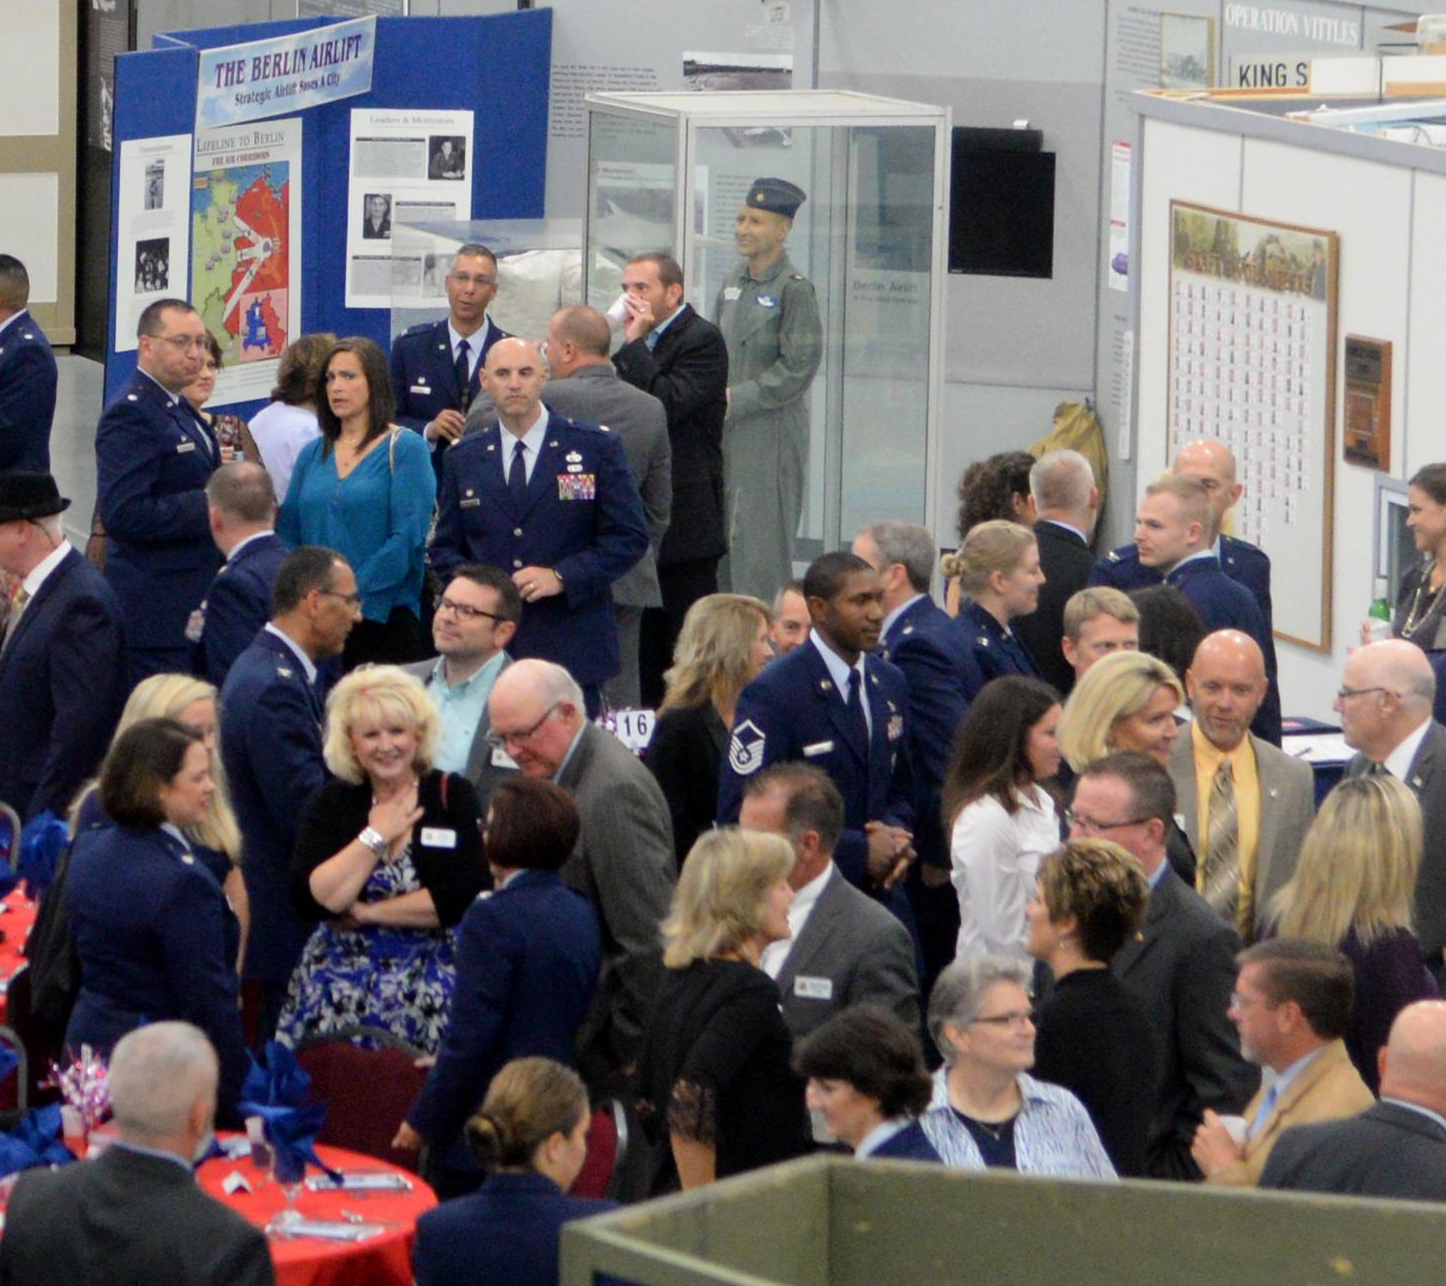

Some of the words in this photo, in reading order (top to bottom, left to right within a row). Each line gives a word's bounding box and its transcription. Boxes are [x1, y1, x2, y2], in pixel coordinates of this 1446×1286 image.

[1225, 3, 1300, 36] OPERATION
[1302, 16, 1358, 46] VITTLES
[215, 59, 246, 89] THE
[251, 46, 308, 82] BERLIN
[309, 34, 362, 70] AIRLIFT
[1239, 63, 1287, 87] KING
[235, 88, 271, 106] Strategic
[275, 82, 297, 98] Airlift
[327, 73, 341, 87] City
[624, 714, 647, 736] 16
